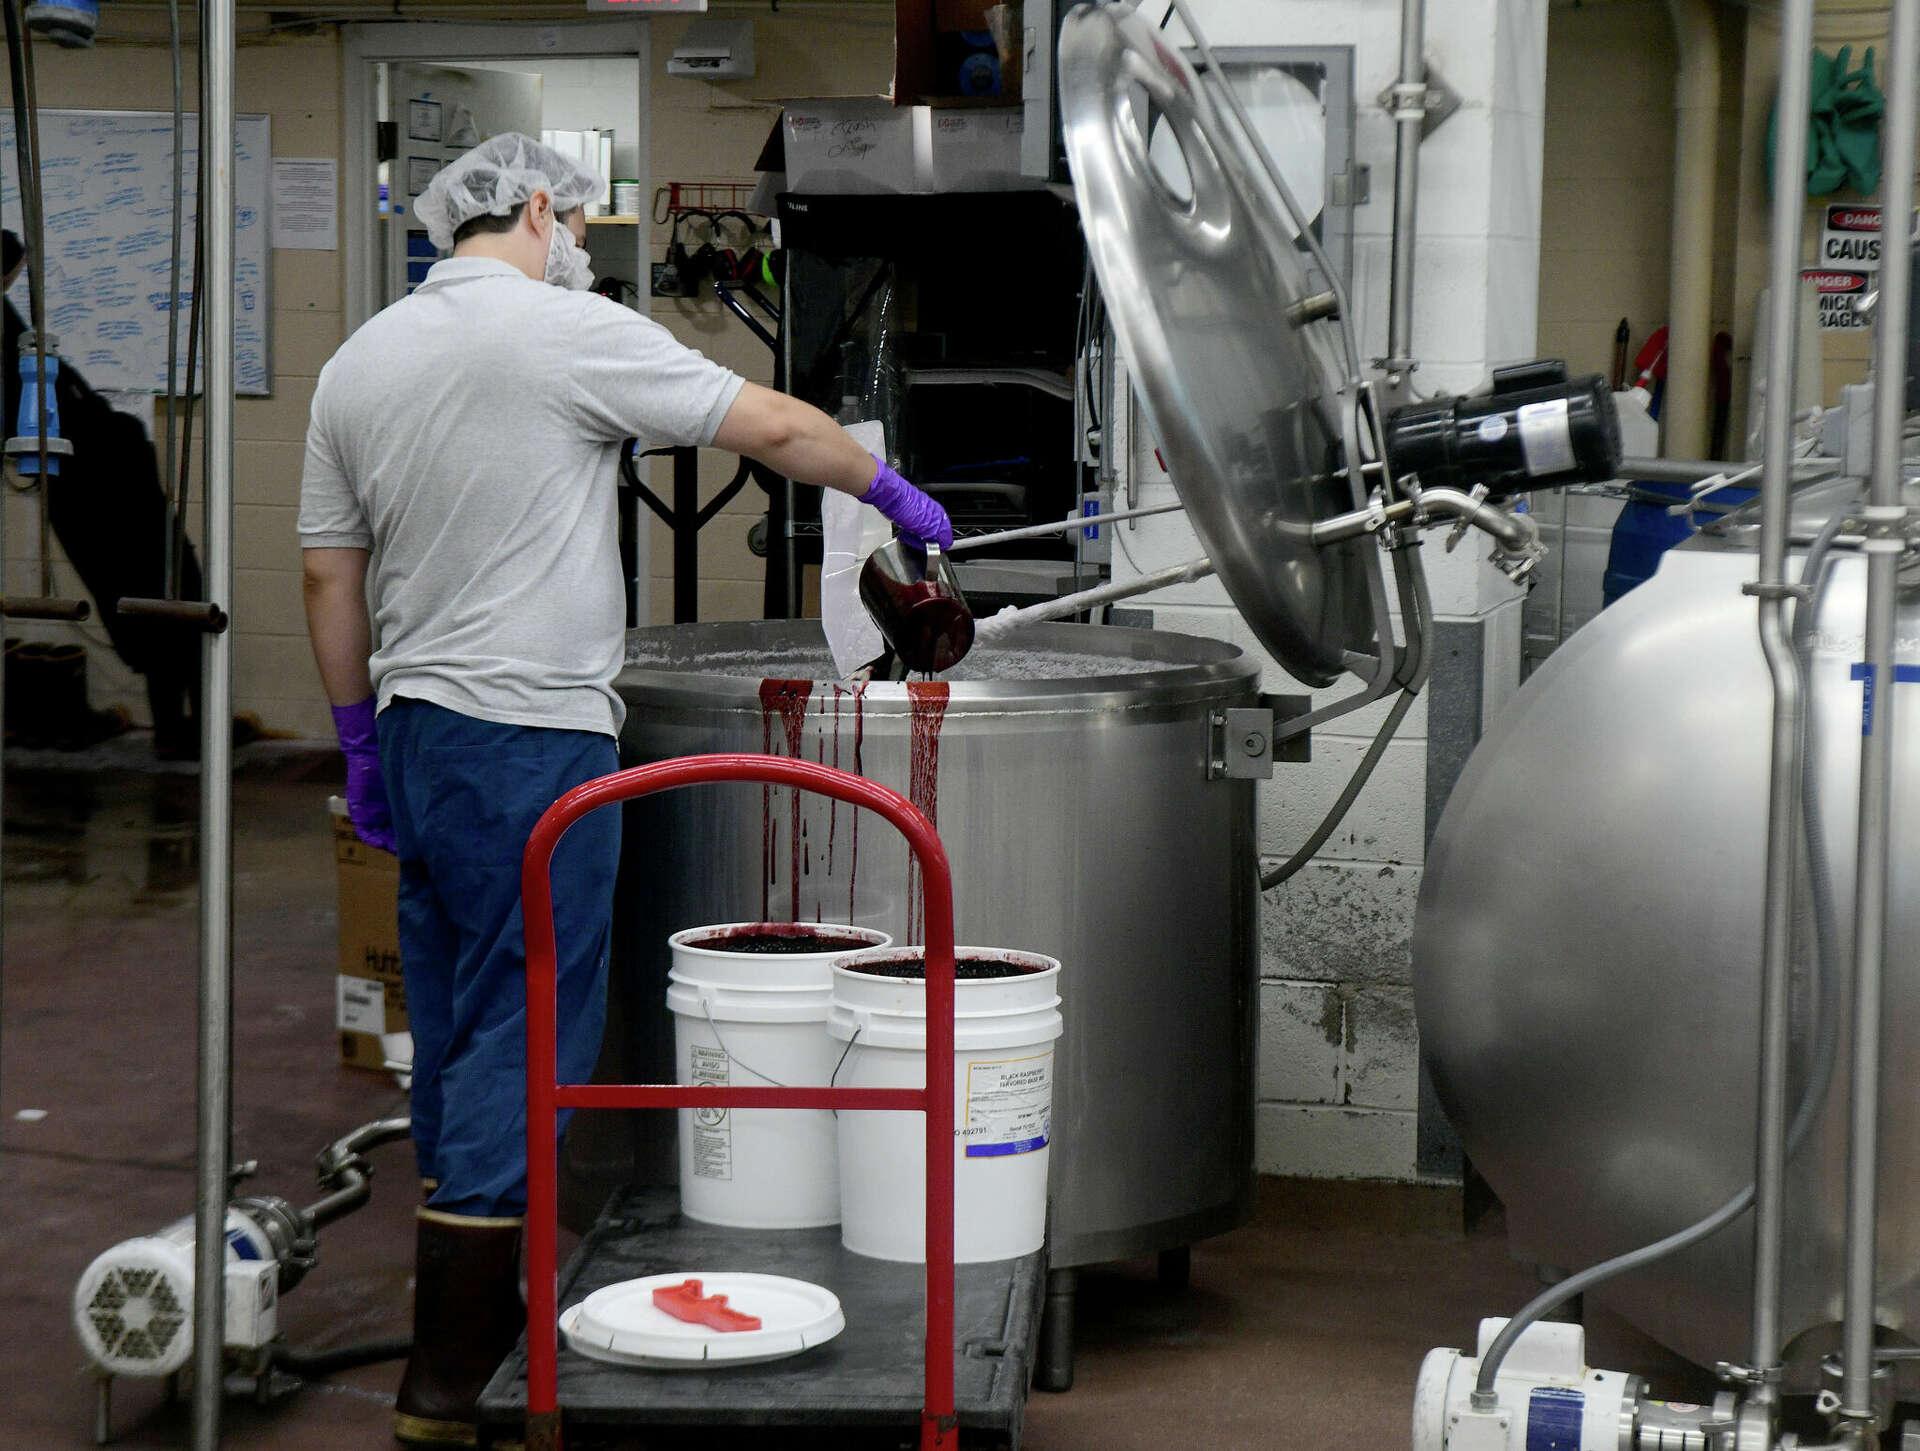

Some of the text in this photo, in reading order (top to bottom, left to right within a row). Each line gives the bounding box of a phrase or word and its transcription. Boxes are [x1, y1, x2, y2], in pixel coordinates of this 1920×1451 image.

[1844, 213, 1881, 226] DANG
[1826, 238, 1881, 260] CAUS
[1804, 276, 1852, 287] ANGER
